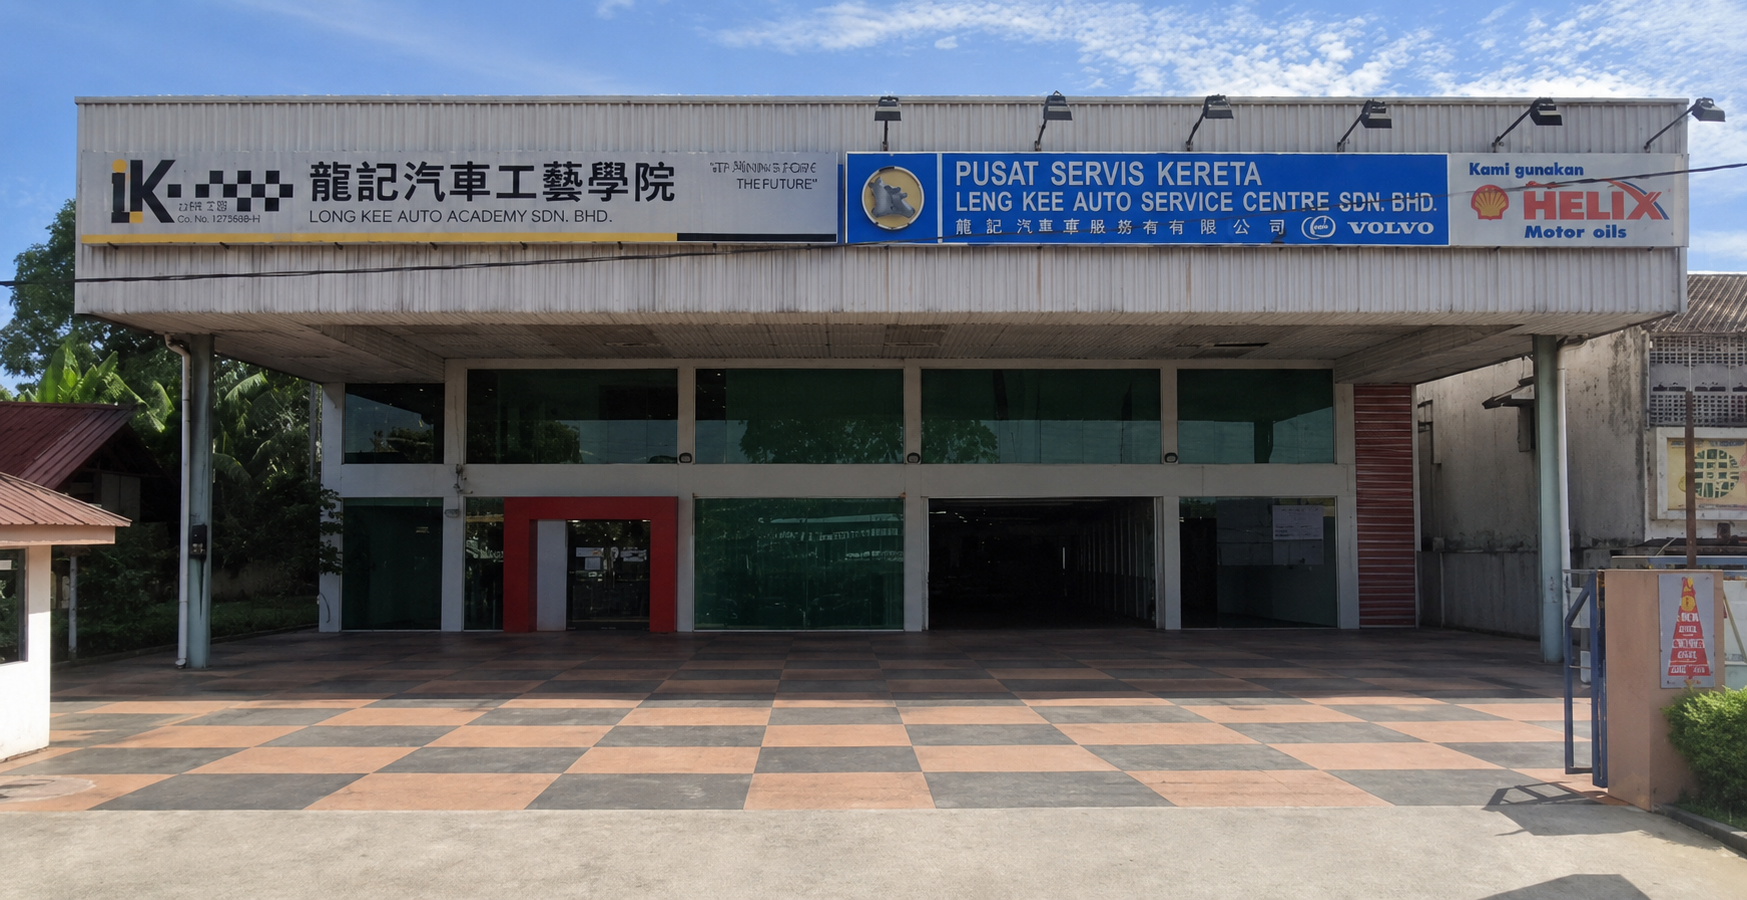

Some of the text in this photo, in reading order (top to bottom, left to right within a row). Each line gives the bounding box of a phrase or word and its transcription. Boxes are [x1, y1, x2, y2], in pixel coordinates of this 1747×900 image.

[956, 161, 1263, 186] PUSAT SERVIS KERETA
[1469, 162, 1584, 179] Kami gunakan
[310, 160, 675, 203] 龍記汽車工藝學院
[737, 178, 760, 190] THE
[956, 192, 1437, 212] LENG KEE AUTO SERVICE CENTRE SDN. BHD.
[1523, 186, 1667, 220] HELIX
[177, 215, 192, 224] Co.
[195, 215, 209, 224] No.
[310, 210, 613, 223] LONG KEE AUTO ACADEMY SDN. BHD.
[1348, 221, 1434, 235] VOLVO
[1524, 224, 1627, 239] Motor oils
